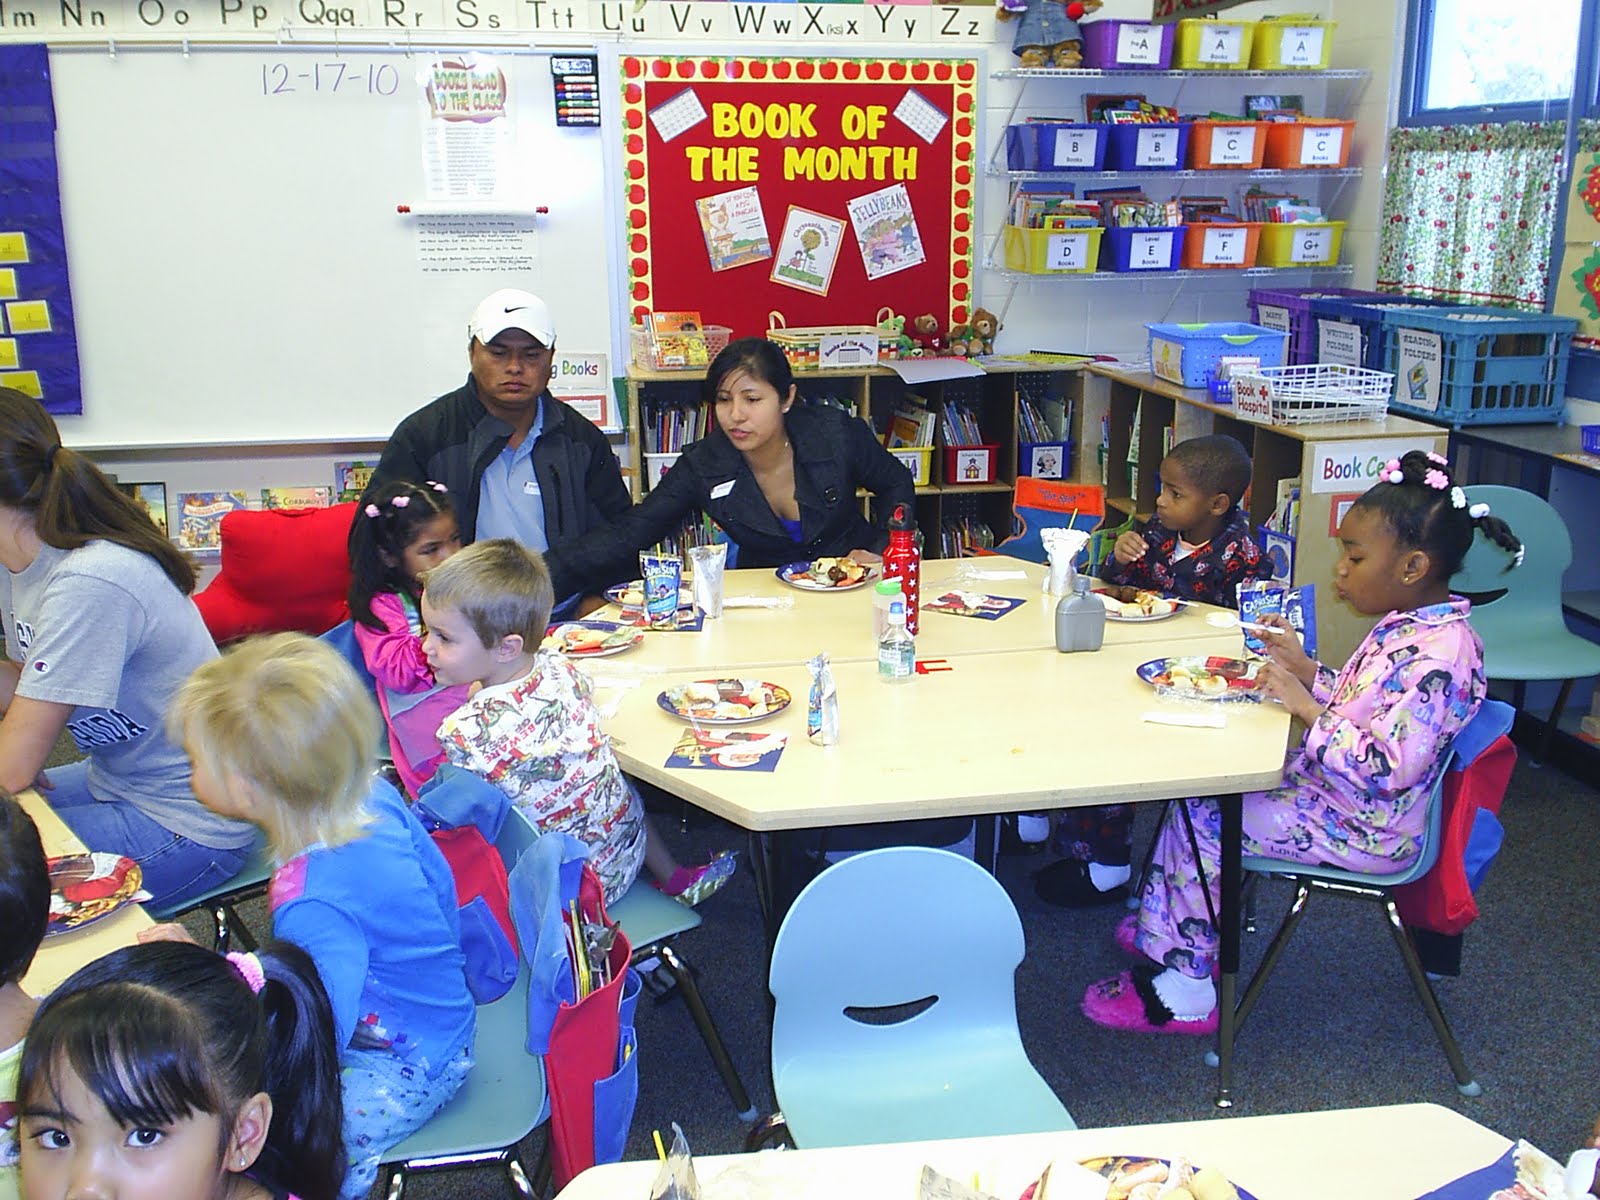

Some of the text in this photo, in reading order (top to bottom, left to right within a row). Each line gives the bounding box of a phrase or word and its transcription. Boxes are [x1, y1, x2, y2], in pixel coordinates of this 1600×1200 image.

[1215, 39, 1225, 50] A
[1296, 40, 1306, 52] A
[262, 63, 399, 96] 12-17-10
[712, 102, 888, 140] BOOK OF
[1071, 141, 1079, 153] B
[1153, 141, 1161, 153] B
[1227, 138, 1238, 151] C
[1316, 140, 1326, 152] C
[685, 146, 918, 182] THE MONTH
[852, 192, 908, 224] JELLYBEANS
[1063, 246, 1072, 257] D
[1148, 245, 1155, 256] E
[1221, 241, 1228, 252] F
[1303, 239, 1320, 251] G+
[1404, 335, 1436, 348] READING
[1404, 348, 1437, 361] FOLDERS
[562, 360, 598, 376] Books
[1237, 381, 1255, 397] Book
[1238, 397, 1270, 416] Hospital
[1324, 456, 1361, 479] Book
[534, 766, 584, 810] BEWARE
